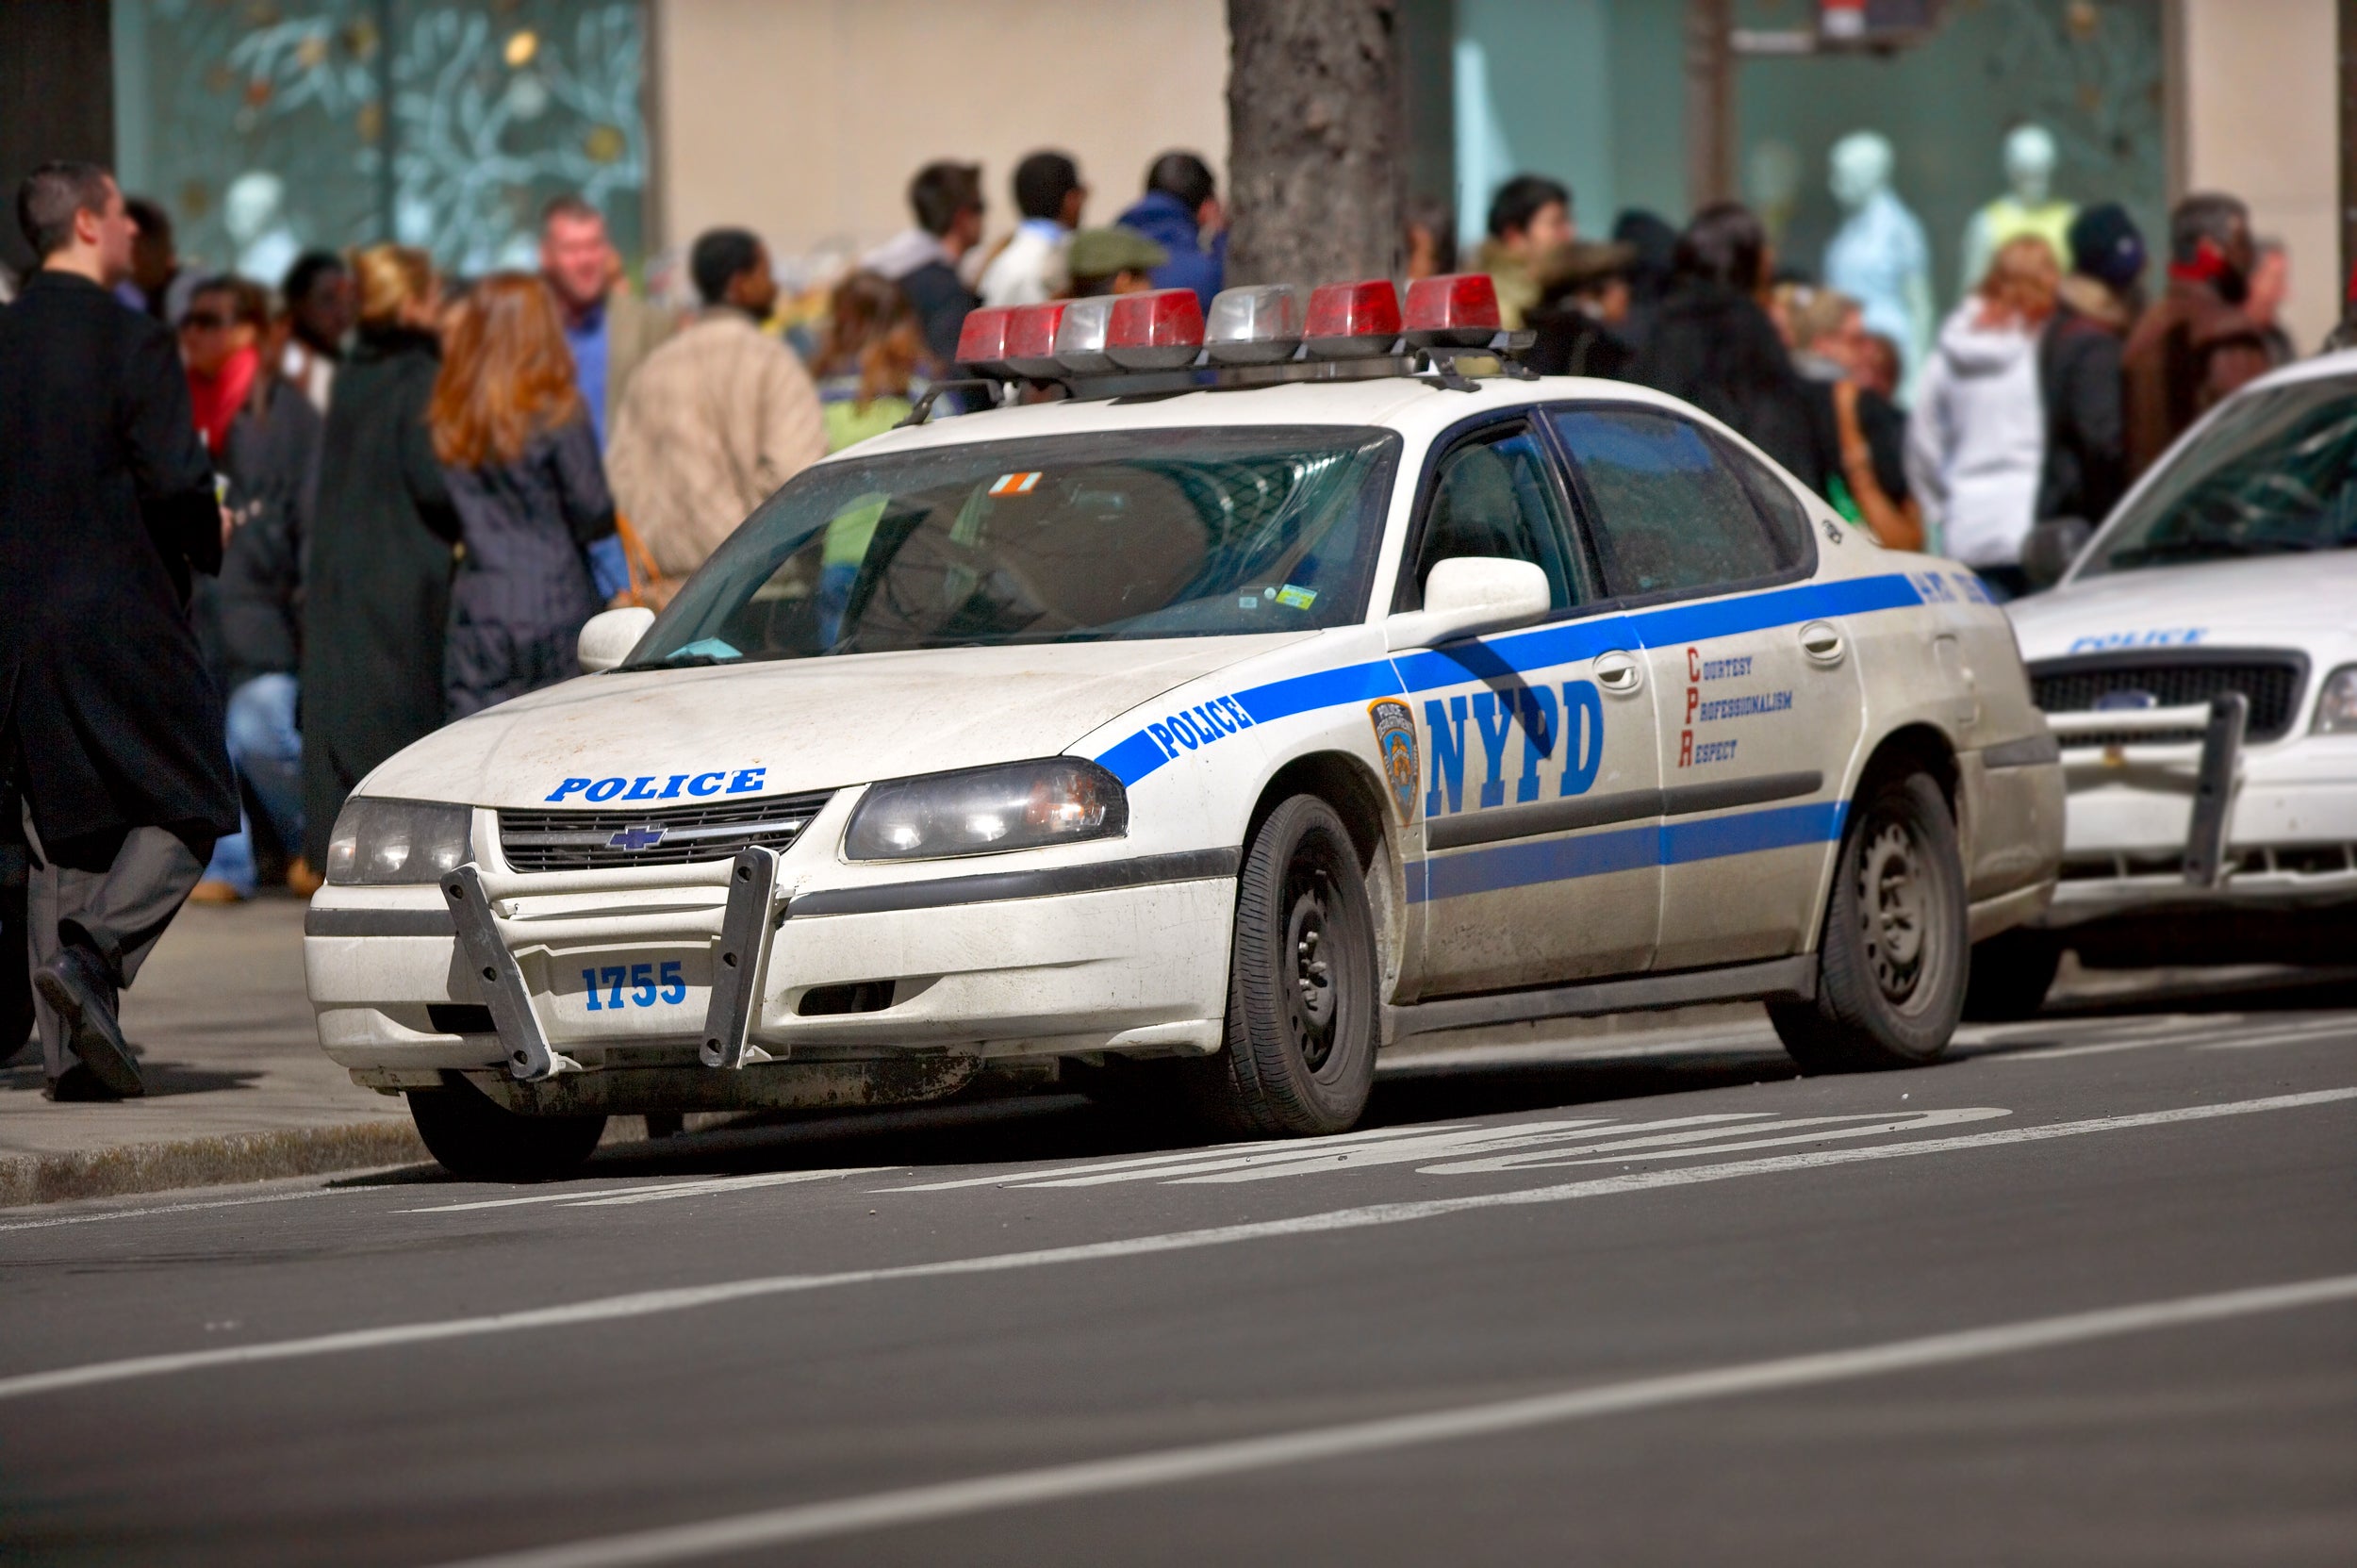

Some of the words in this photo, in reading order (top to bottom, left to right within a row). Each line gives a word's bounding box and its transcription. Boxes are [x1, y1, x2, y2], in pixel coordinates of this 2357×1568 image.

[2069, 626, 2211, 655] POLICE
[1146, 696, 1254, 759] POLICE
[1424, 680, 1605, 818] NYPD
[544, 767, 766, 802] POLICE
[582, 961, 686, 1011] 1755
